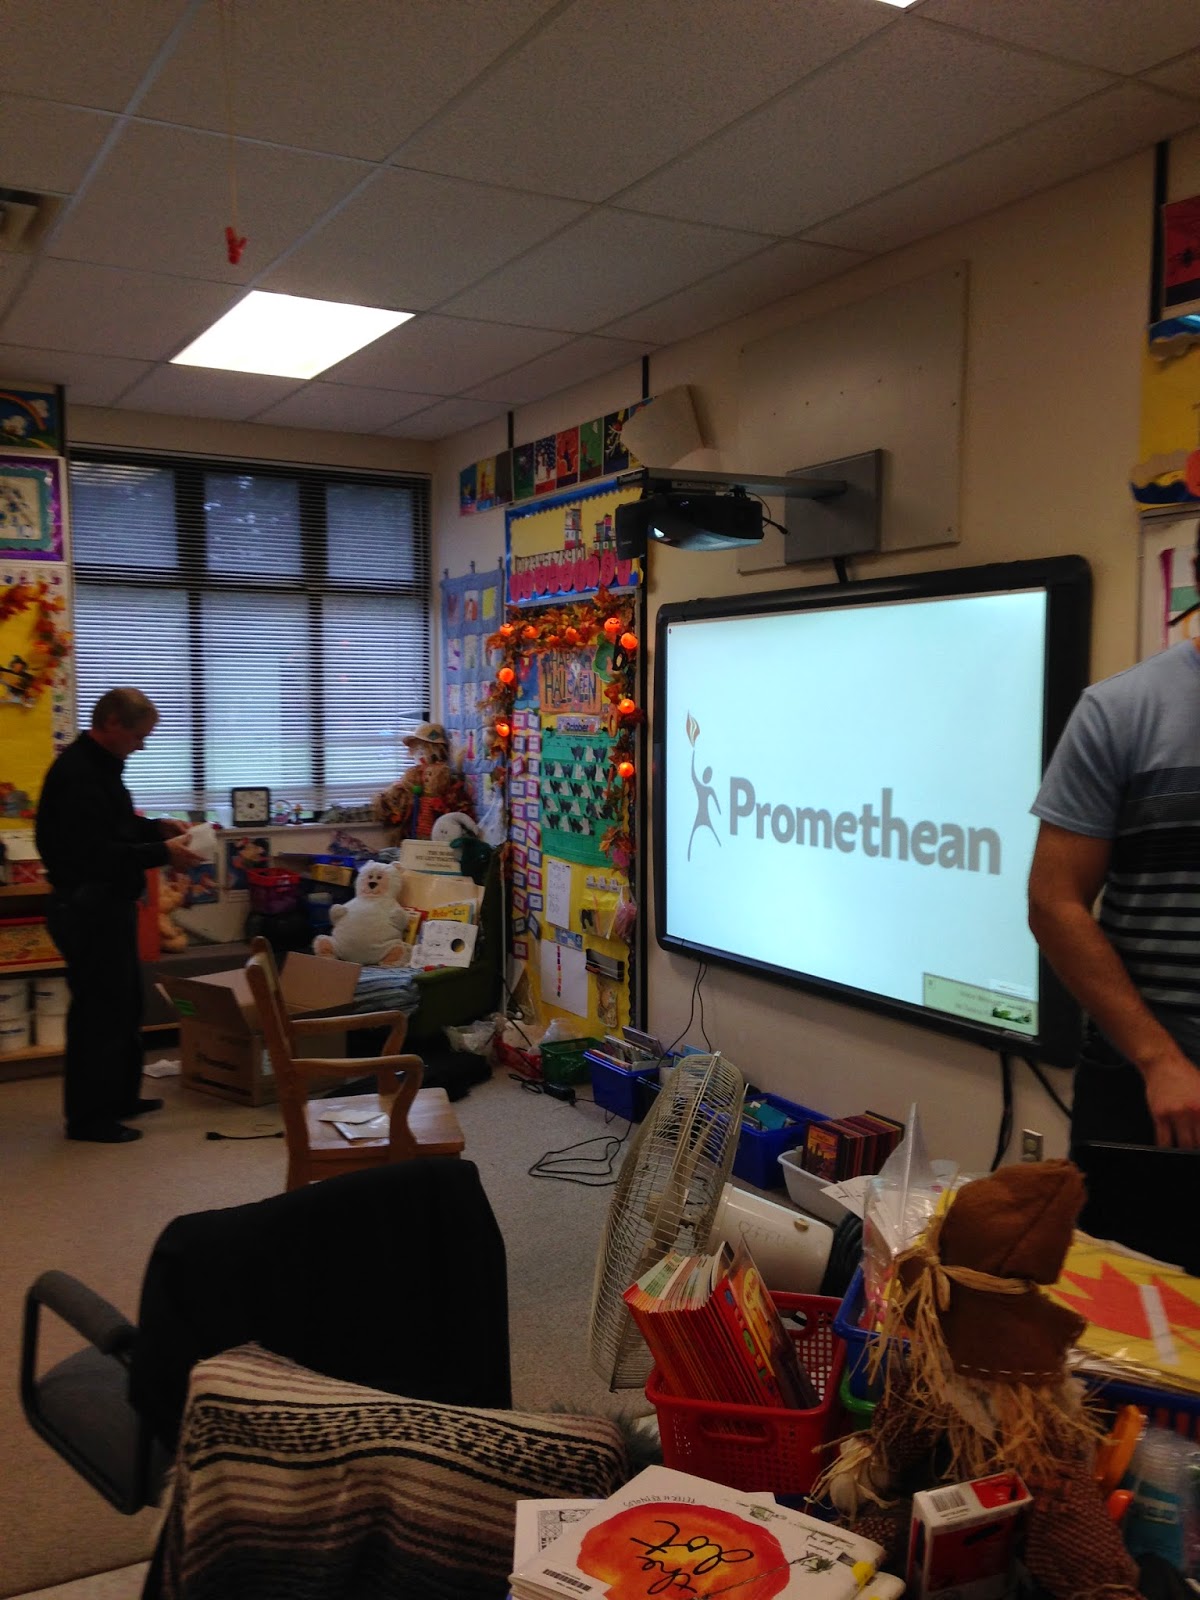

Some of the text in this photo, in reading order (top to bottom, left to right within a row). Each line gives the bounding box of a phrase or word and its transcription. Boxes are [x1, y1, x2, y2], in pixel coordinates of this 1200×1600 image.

[566, 722, 589, 732] October
[729, 776, 1001, 875] Promethean
[623, 1494, 661, 1507] REYNOLDS
[671, 1495, 696, 1504] PETER
[631, 1520, 754, 1575] dot
[635, 1555, 698, 1596] the
